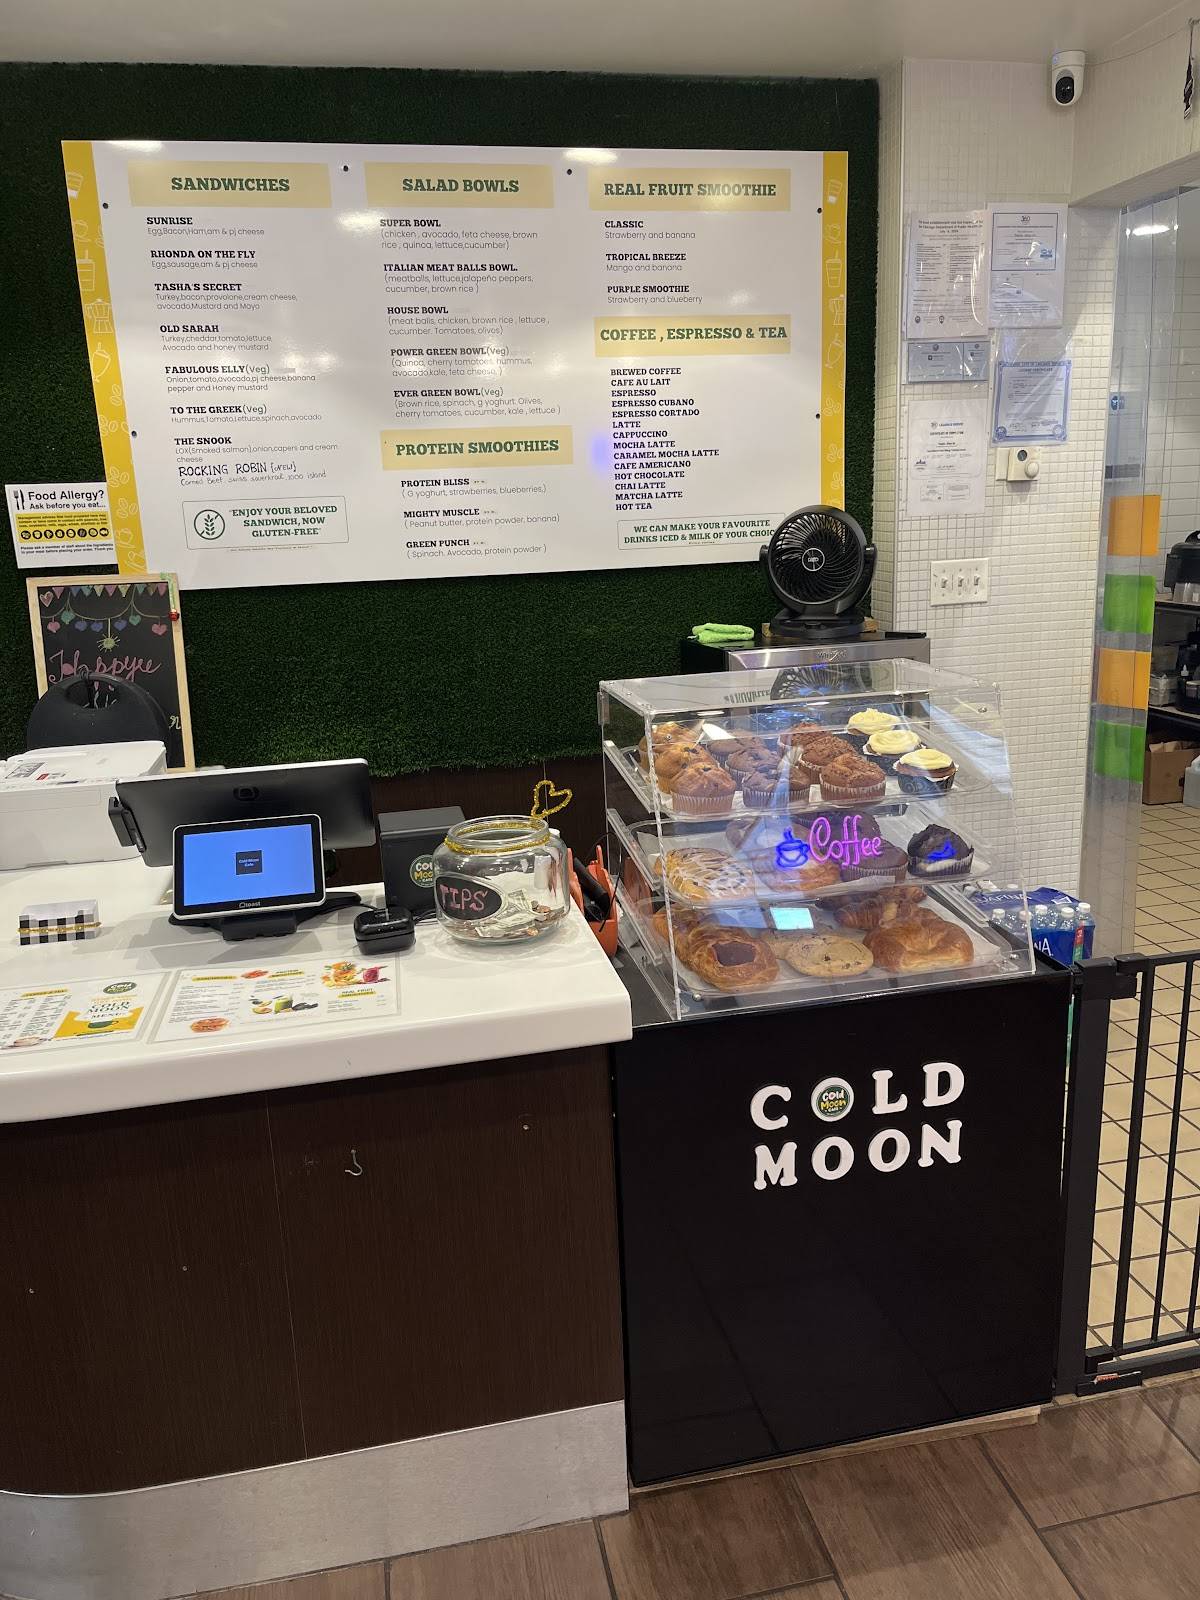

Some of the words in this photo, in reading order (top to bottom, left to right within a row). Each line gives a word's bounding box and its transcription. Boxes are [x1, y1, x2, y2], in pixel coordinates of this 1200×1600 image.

[171, 178, 290, 192] SANDWICHES
[402, 179, 459, 192] SALAD
[463, 180, 519, 193] BOWLS
[604, 184, 644, 196] REAL
[649, 184, 693, 196] FRUIT
[697, 184, 776, 196] SMOOTHIE
[147, 217, 193, 225] SUNRISE
[462, 231, 478, 239] feta
[605, 231, 646, 240] Strawberry
[384, 264, 424, 272] ITALIAN
[427, 264, 455, 272] MEAT
[457, 264, 487, 272] BALLS
[606, 265, 633, 273] Mango
[386, 285, 430, 294] cucumber,
[608, 296, 649, 304] Strawberry
[667, 295, 702, 304] blueberry
[240, 303, 260, 311] Mayo
[601, 329, 656, 341] COFFEE
[667, 328, 742, 340] ESPRESSO
[746, 328, 755, 338] &
[759, 327, 787, 339] TEA
[168, 385, 194, 393] pepper
[612, 400, 656, 408] ESPRESSO
[659, 399, 694, 407] CUBANO
[396, 410, 421, 418] cherry
[612, 411, 657, 419] ESPRESSO
[659, 409, 700, 417] CORTADO
[613, 421, 641, 429] LATTE
[613, 431, 667, 439] CAPPUCCINO
[197, 437, 232, 445] SNOOK
[396, 443, 464, 456] PROTEIN
[469, 440, 559, 454] SMOOTHIES
[614, 452, 656, 460] CARAMEL
[179, 465, 228, 477] ROCKING
[236, 462, 267, 474] ROBIN
[639, 461, 691, 469] AMERICANO
[634, 471, 685, 479] CHOCOLATE
[638, 482, 666, 490] LATTE
[28, 491, 56, 500] Food
[60, 490, 104, 501] Allergy?
[264, 507, 291, 515] YOUR
[294, 505, 337, 514] BELOVED
[404, 510, 440, 518] MIGHTY
[443, 509, 480, 517] MUSCLE
[244, 518, 300, 527] SANDWICH,
[302, 517, 325, 525] NOW
[466, 517, 493, 526] protein
[670, 523, 696, 531] MAKE
[698, 522, 720, 530] YOUR
[722, 520, 770, 529] FAVOURITE
[624, 535, 658, 544] DRINKS
[660, 534, 679, 542] ICED
[689, 532, 711, 540] MILK
[439, 539, 470, 547] PUNCH
[485, 547, 512, 556] protein
[514, 546, 541, 555] powder
[809, 814, 883, 866] Coffee
[440, 884, 488, 911] TIPS
[754, 1120, 963, 1190] MOON
